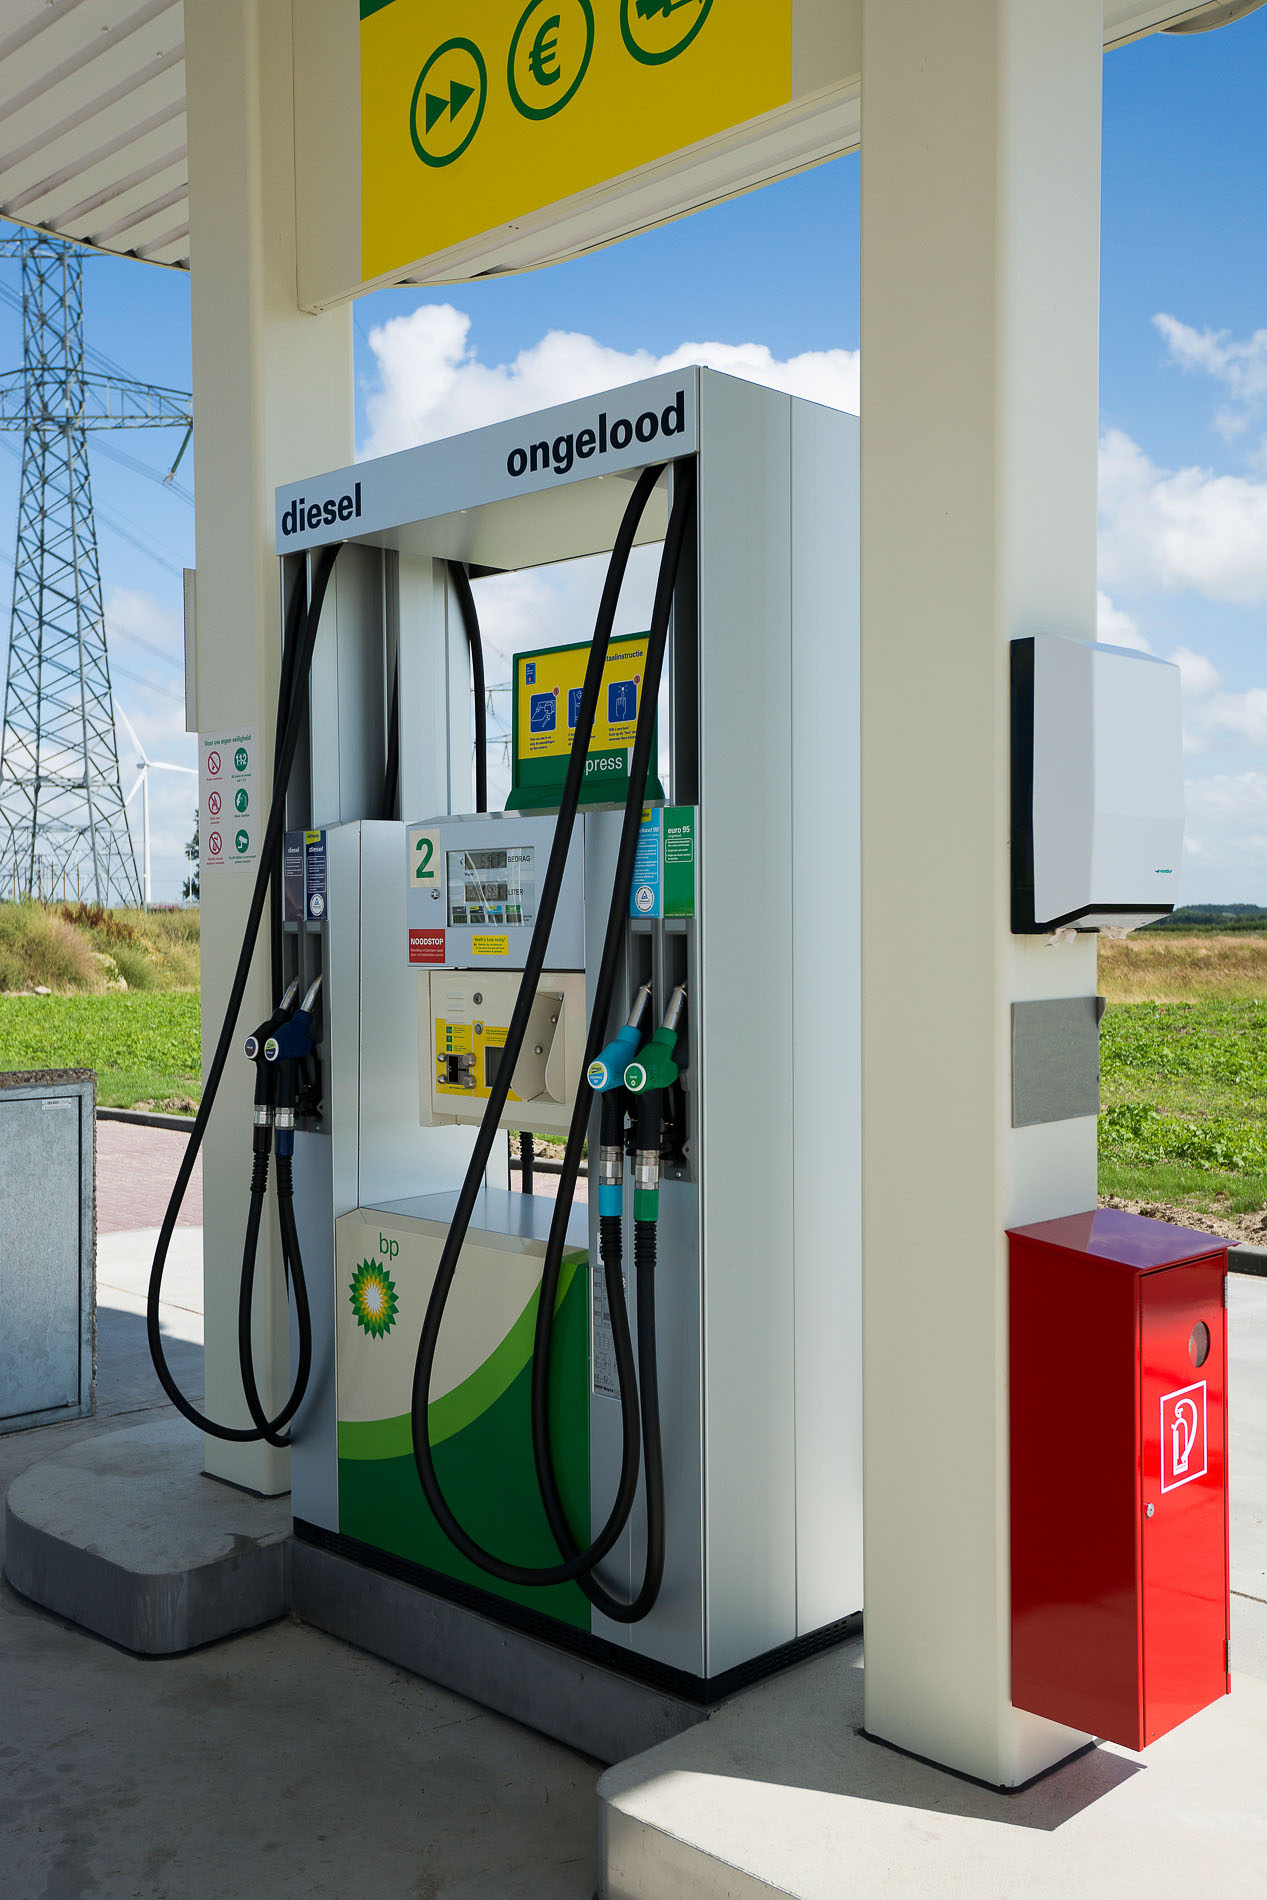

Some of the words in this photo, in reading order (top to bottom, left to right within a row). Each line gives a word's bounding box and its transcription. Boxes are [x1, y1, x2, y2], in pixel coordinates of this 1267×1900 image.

[506, 390, 685, 477] ongelood
[281, 482, 362, 537] diesel
[606, 650, 643, 662] taalinstructie
[584, 756, 623, 776] press
[682, 825, 690, 833] 95
[415, 838, 435, 879] 2
[507, 855, 531, 863] BEDRAG
[507, 888, 524, 896] LITER
[410, 937, 444, 946] NOODSTOP
[379, 1231, 399, 1261] bp
